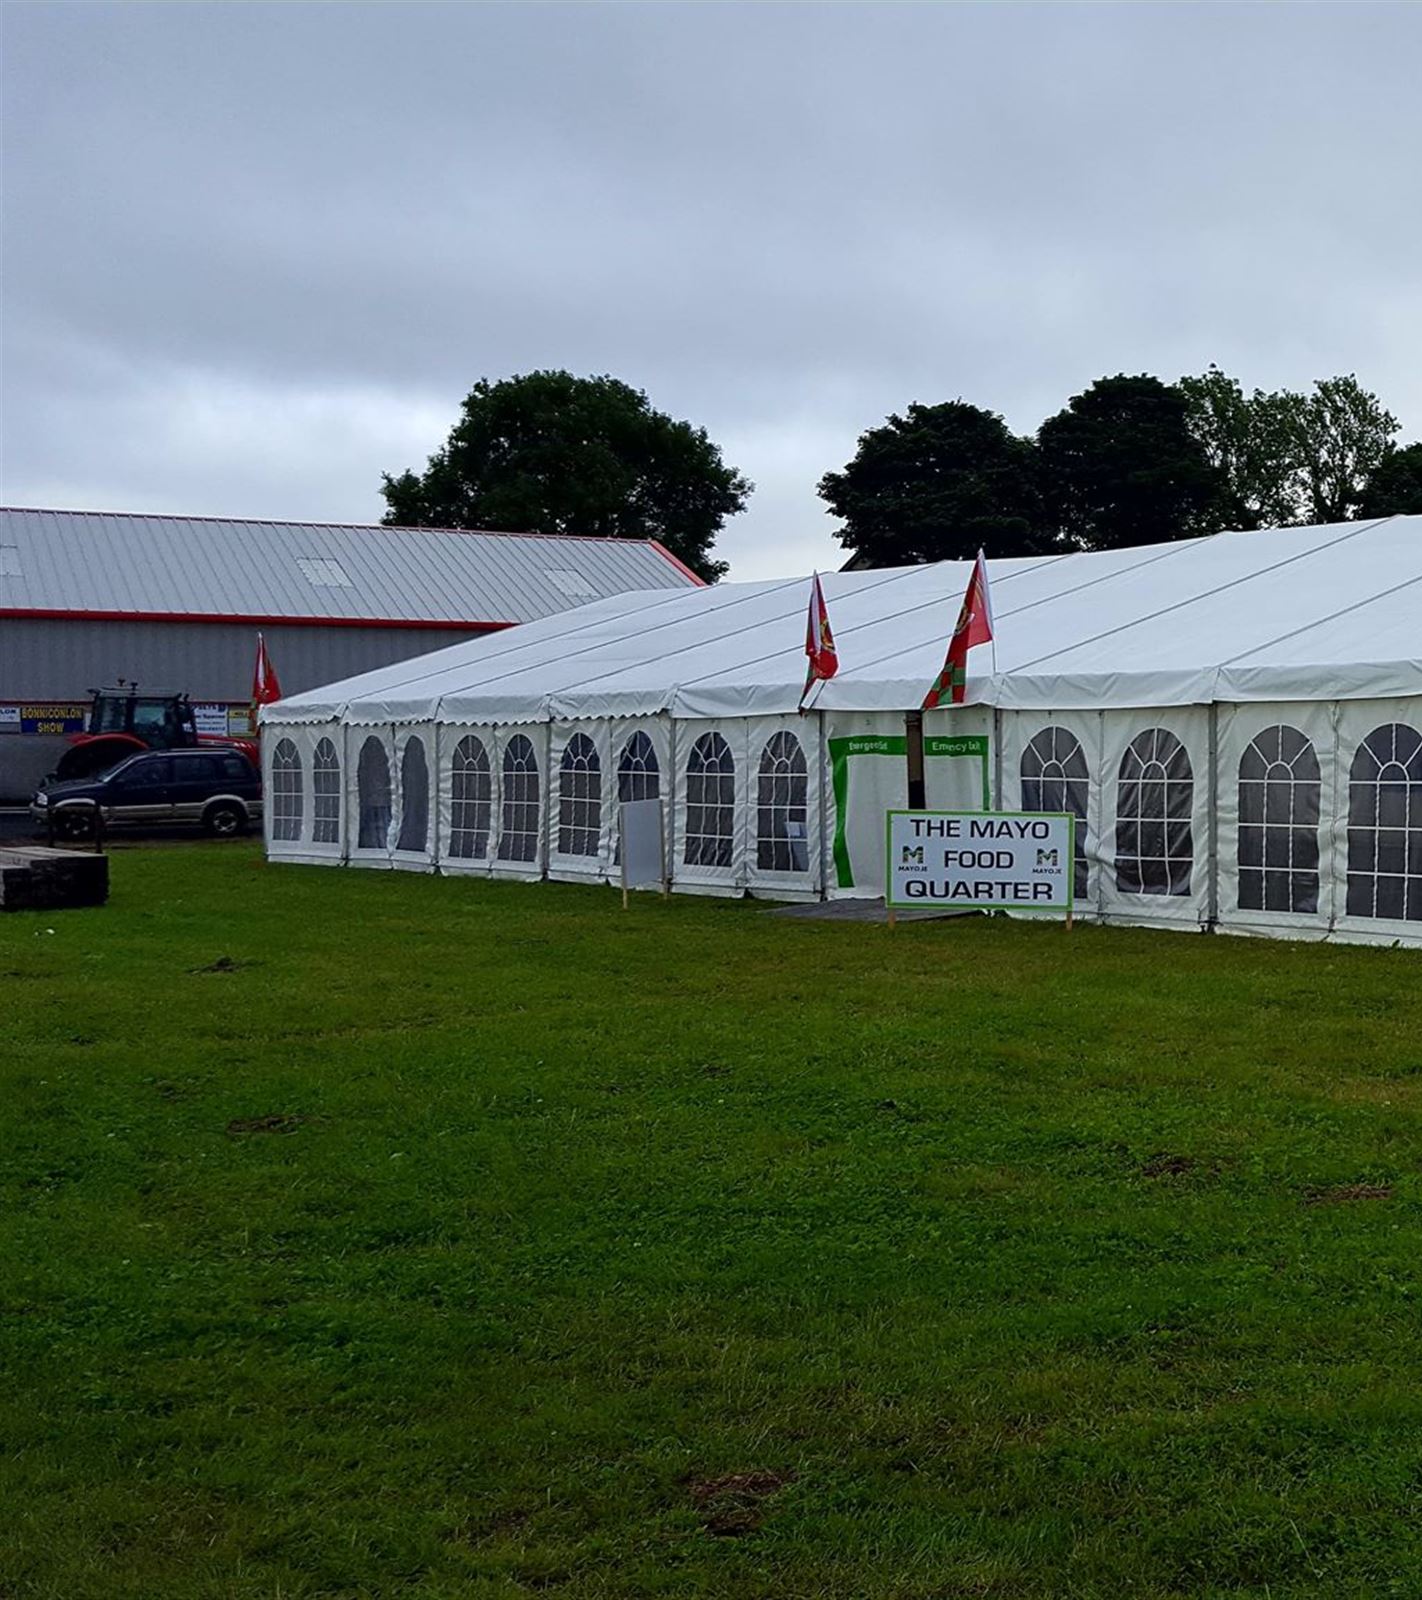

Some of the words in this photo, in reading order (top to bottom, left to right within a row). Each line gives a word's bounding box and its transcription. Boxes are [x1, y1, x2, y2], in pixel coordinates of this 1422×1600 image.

[38, 722, 64, 733] SHOW
[910, 819, 961, 838] THE
[970, 820, 1050, 839] MAYO
[944, 851, 1014, 869] FOOD
[905, 880, 1053, 900] QUARTER
